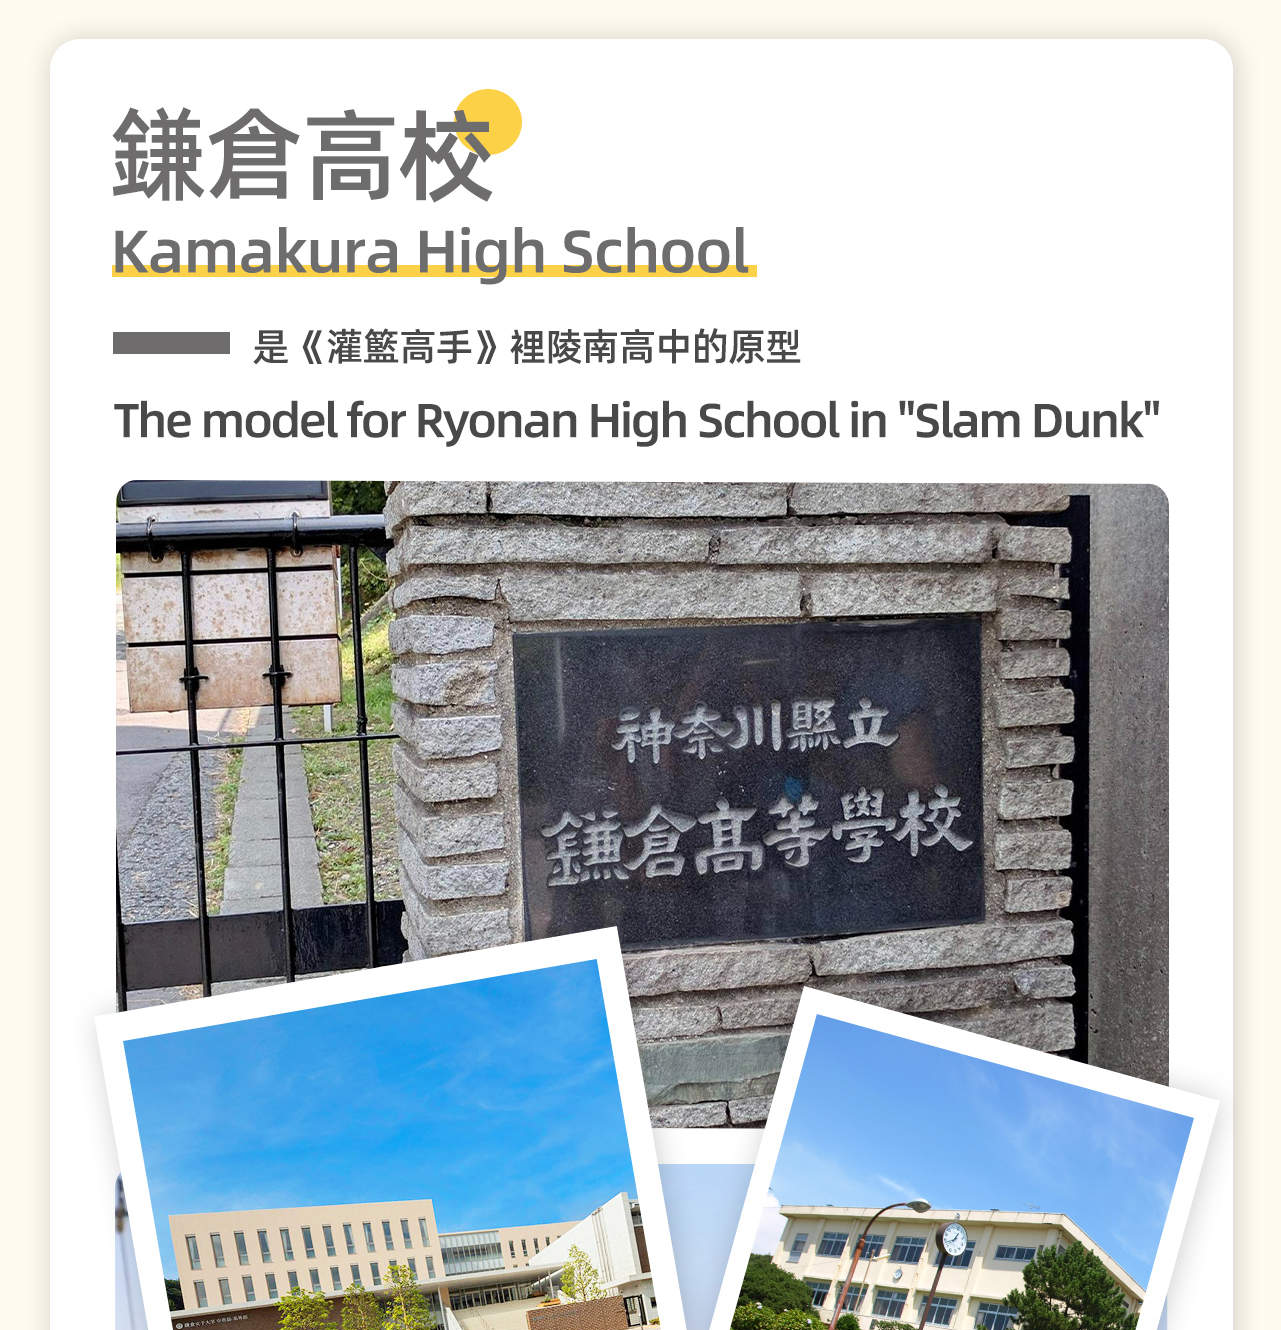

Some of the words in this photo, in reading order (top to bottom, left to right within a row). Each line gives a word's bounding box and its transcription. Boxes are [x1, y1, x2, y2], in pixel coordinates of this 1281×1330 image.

[613, 698, 899, 764] 神奈川縣立
